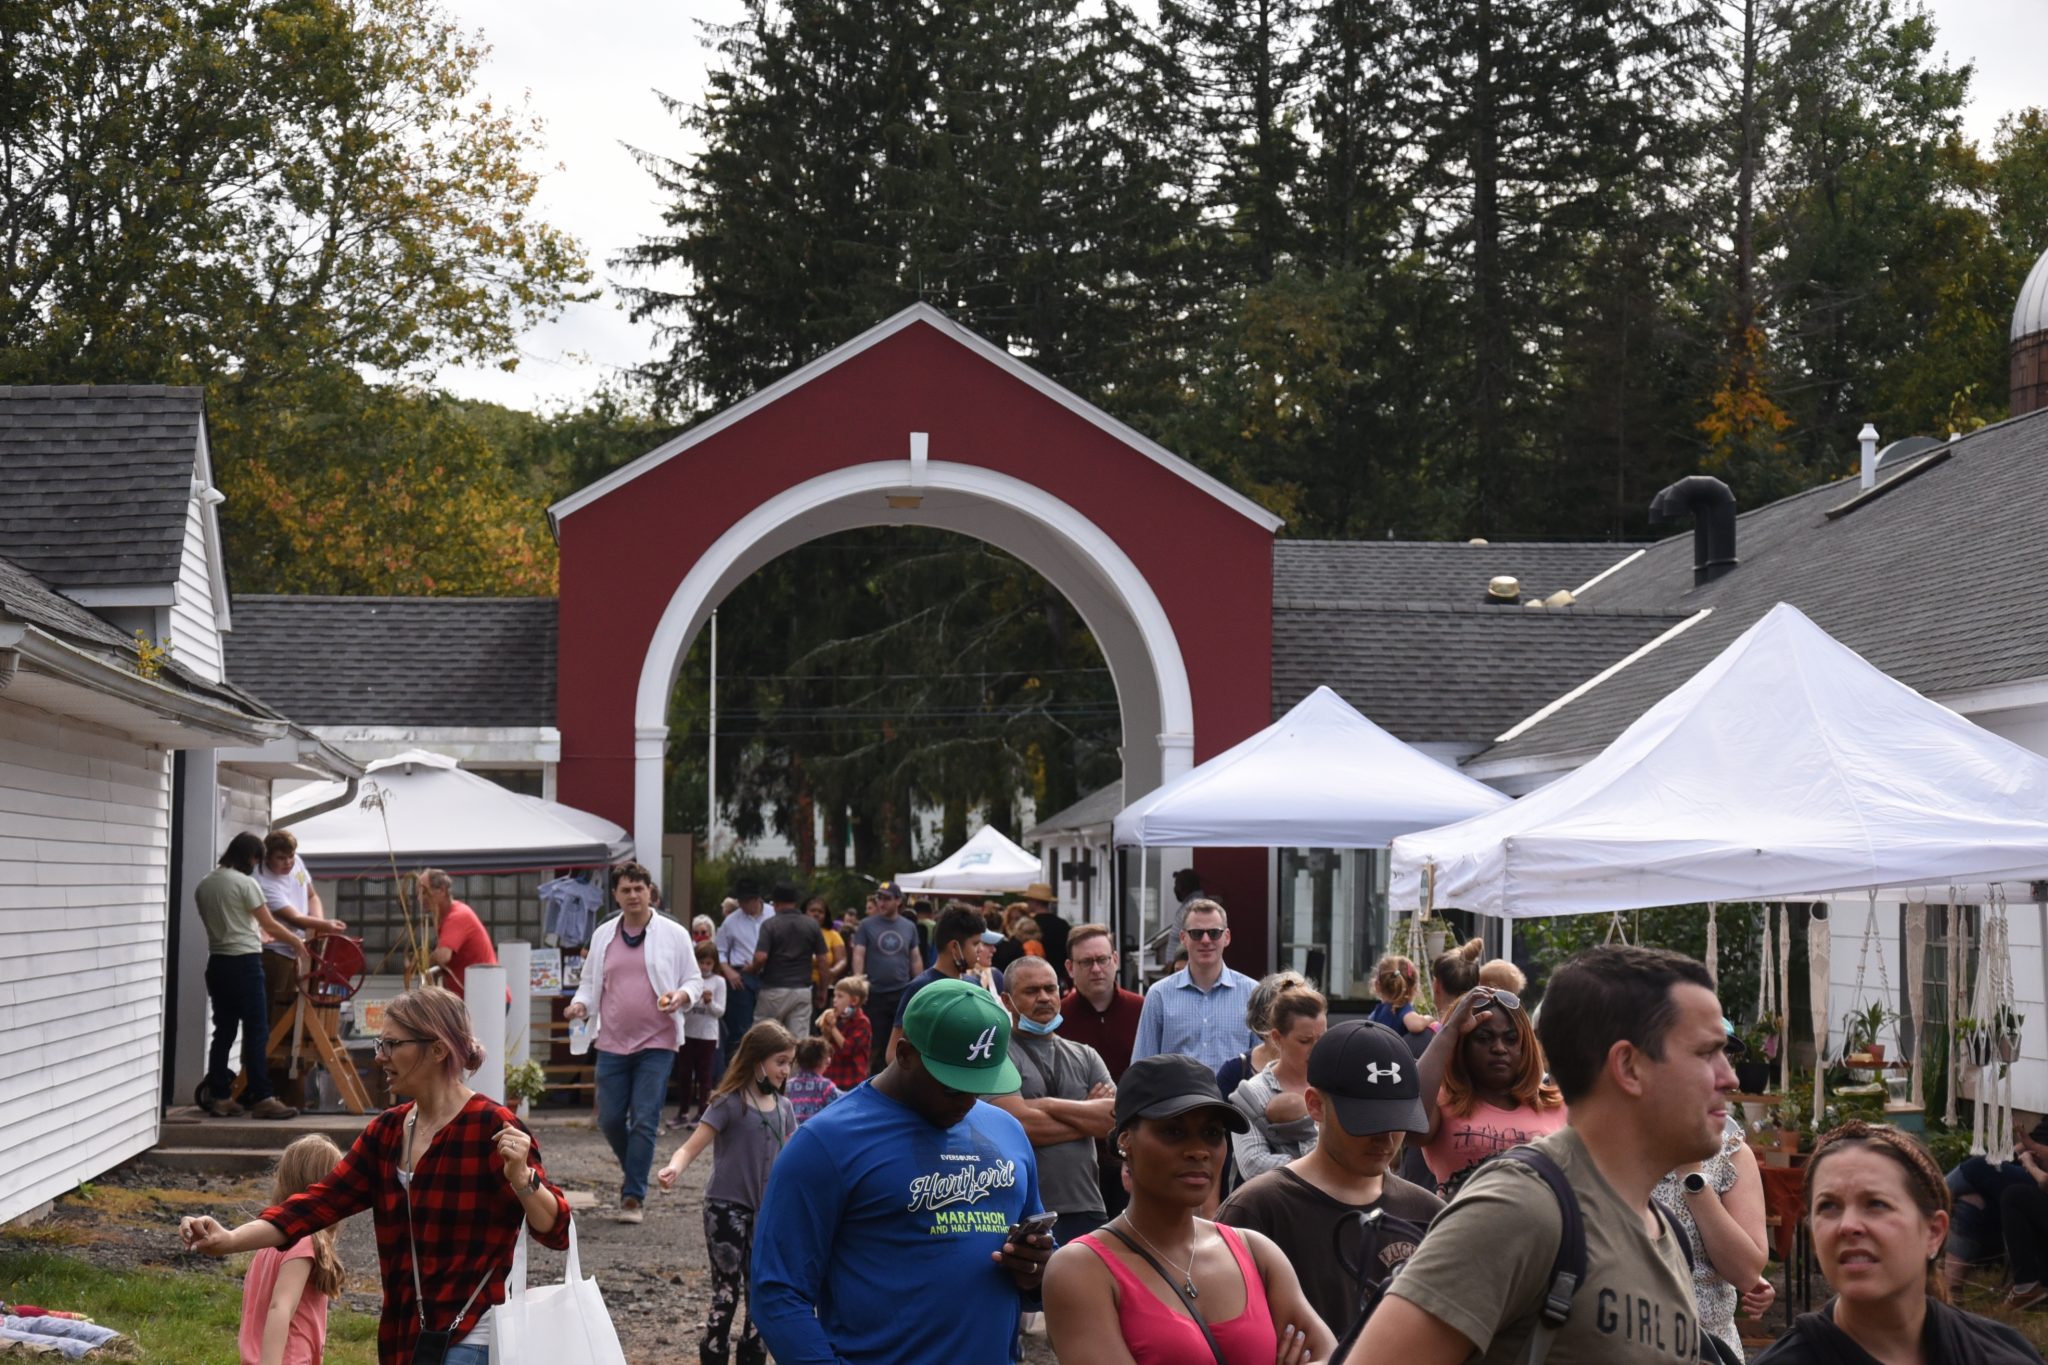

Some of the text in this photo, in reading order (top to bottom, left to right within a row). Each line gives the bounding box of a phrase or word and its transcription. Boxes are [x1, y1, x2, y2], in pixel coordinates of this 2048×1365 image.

[940, 1154, 981, 1162] EVERSOURCE
[908, 1159, 1015, 1212] Hartford
[935, 1211, 1006, 1225] MARATHON
[930, 1225, 1010, 1235] AND HALF MARATHO
[1596, 1287, 1666, 1352] GIRL
